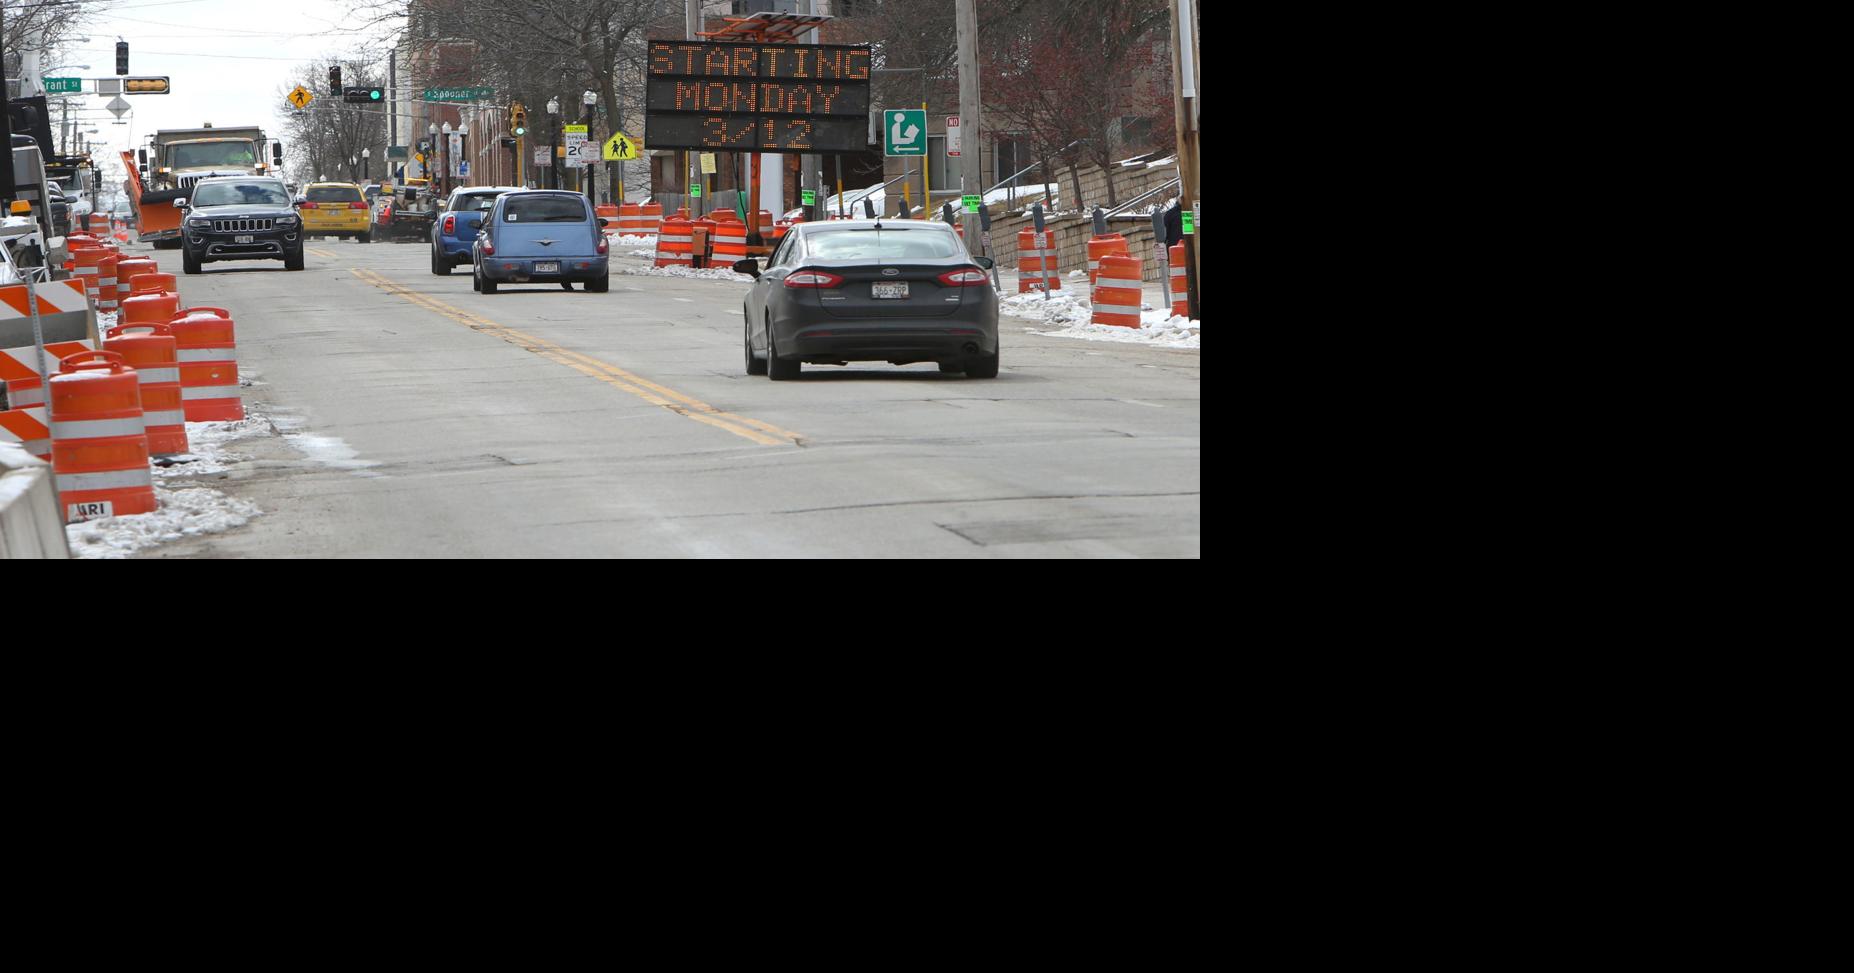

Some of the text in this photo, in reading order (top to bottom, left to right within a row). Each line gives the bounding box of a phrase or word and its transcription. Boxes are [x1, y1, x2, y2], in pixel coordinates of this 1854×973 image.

[650, 44, 869, 80] STARTING
[44, 80, 67, 90] rant
[675, 81, 840, 114] MONDAY
[703, 117, 812, 149] 3/12
[948, 118, 959, 127] NO
